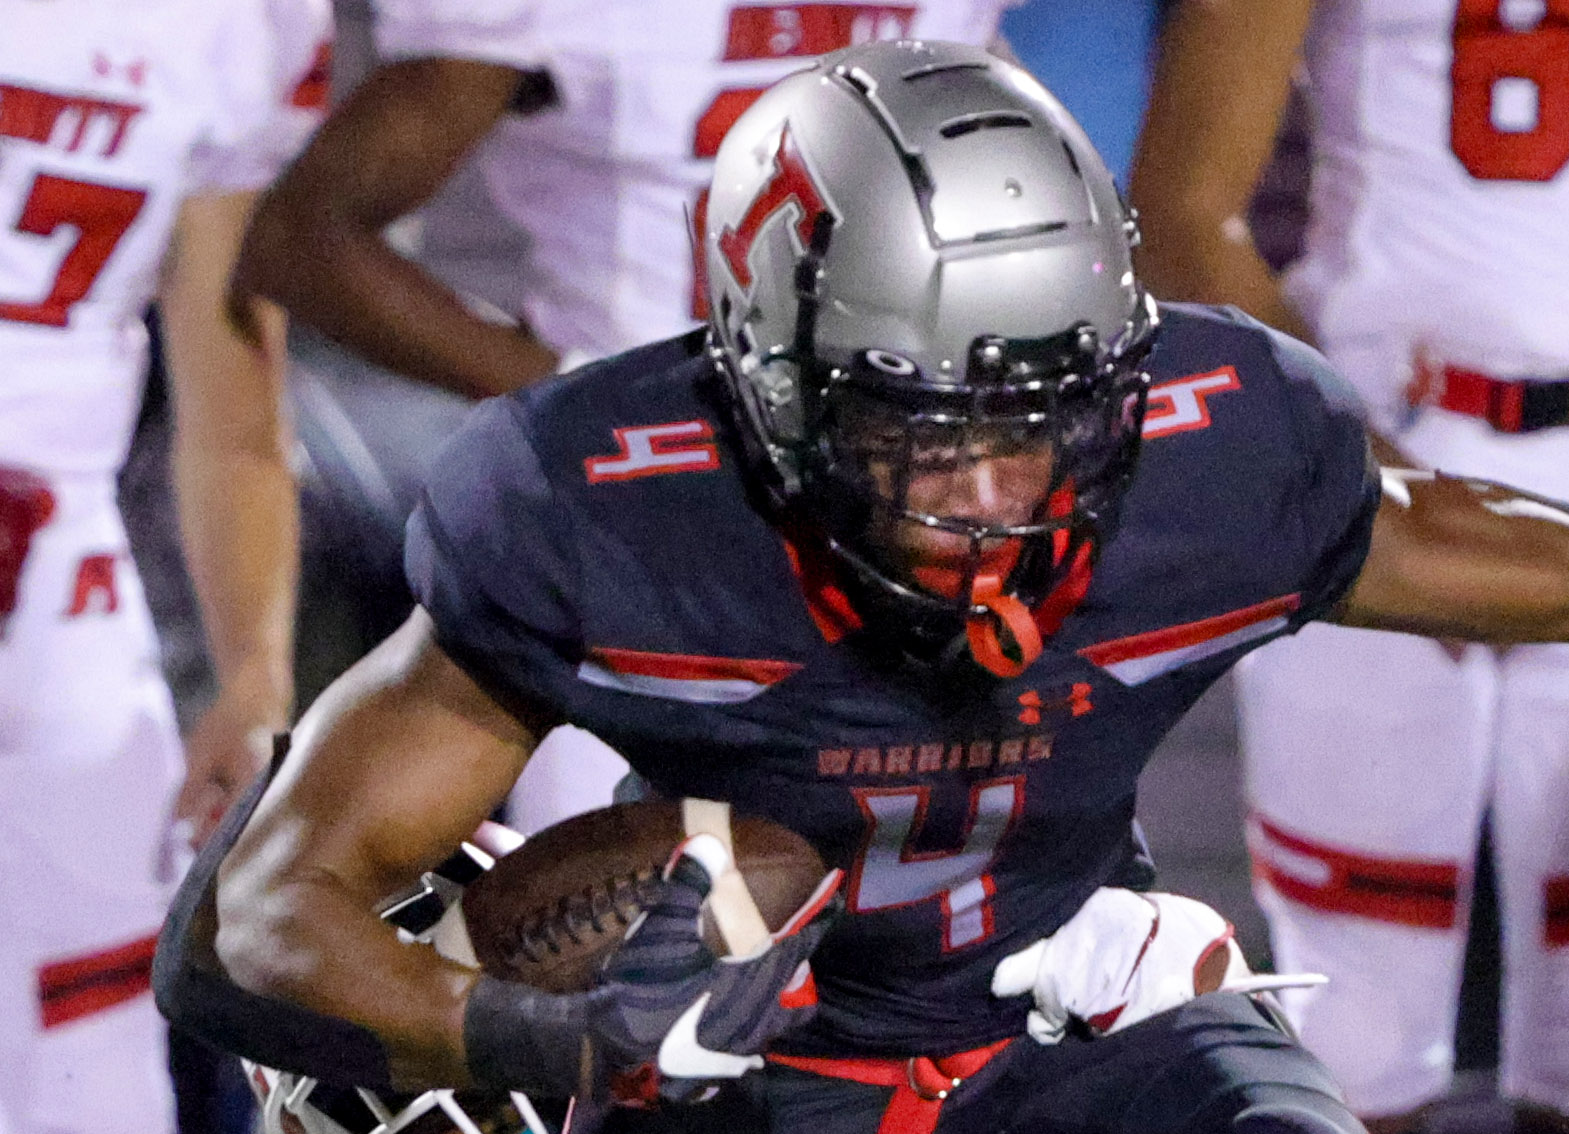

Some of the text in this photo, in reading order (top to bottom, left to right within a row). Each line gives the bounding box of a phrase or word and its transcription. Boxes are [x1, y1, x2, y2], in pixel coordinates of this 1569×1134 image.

[583, 417, 722, 486] 4
[817, 735, 1055, 776] WARRIORS
[846, 774, 1028, 954] 4
